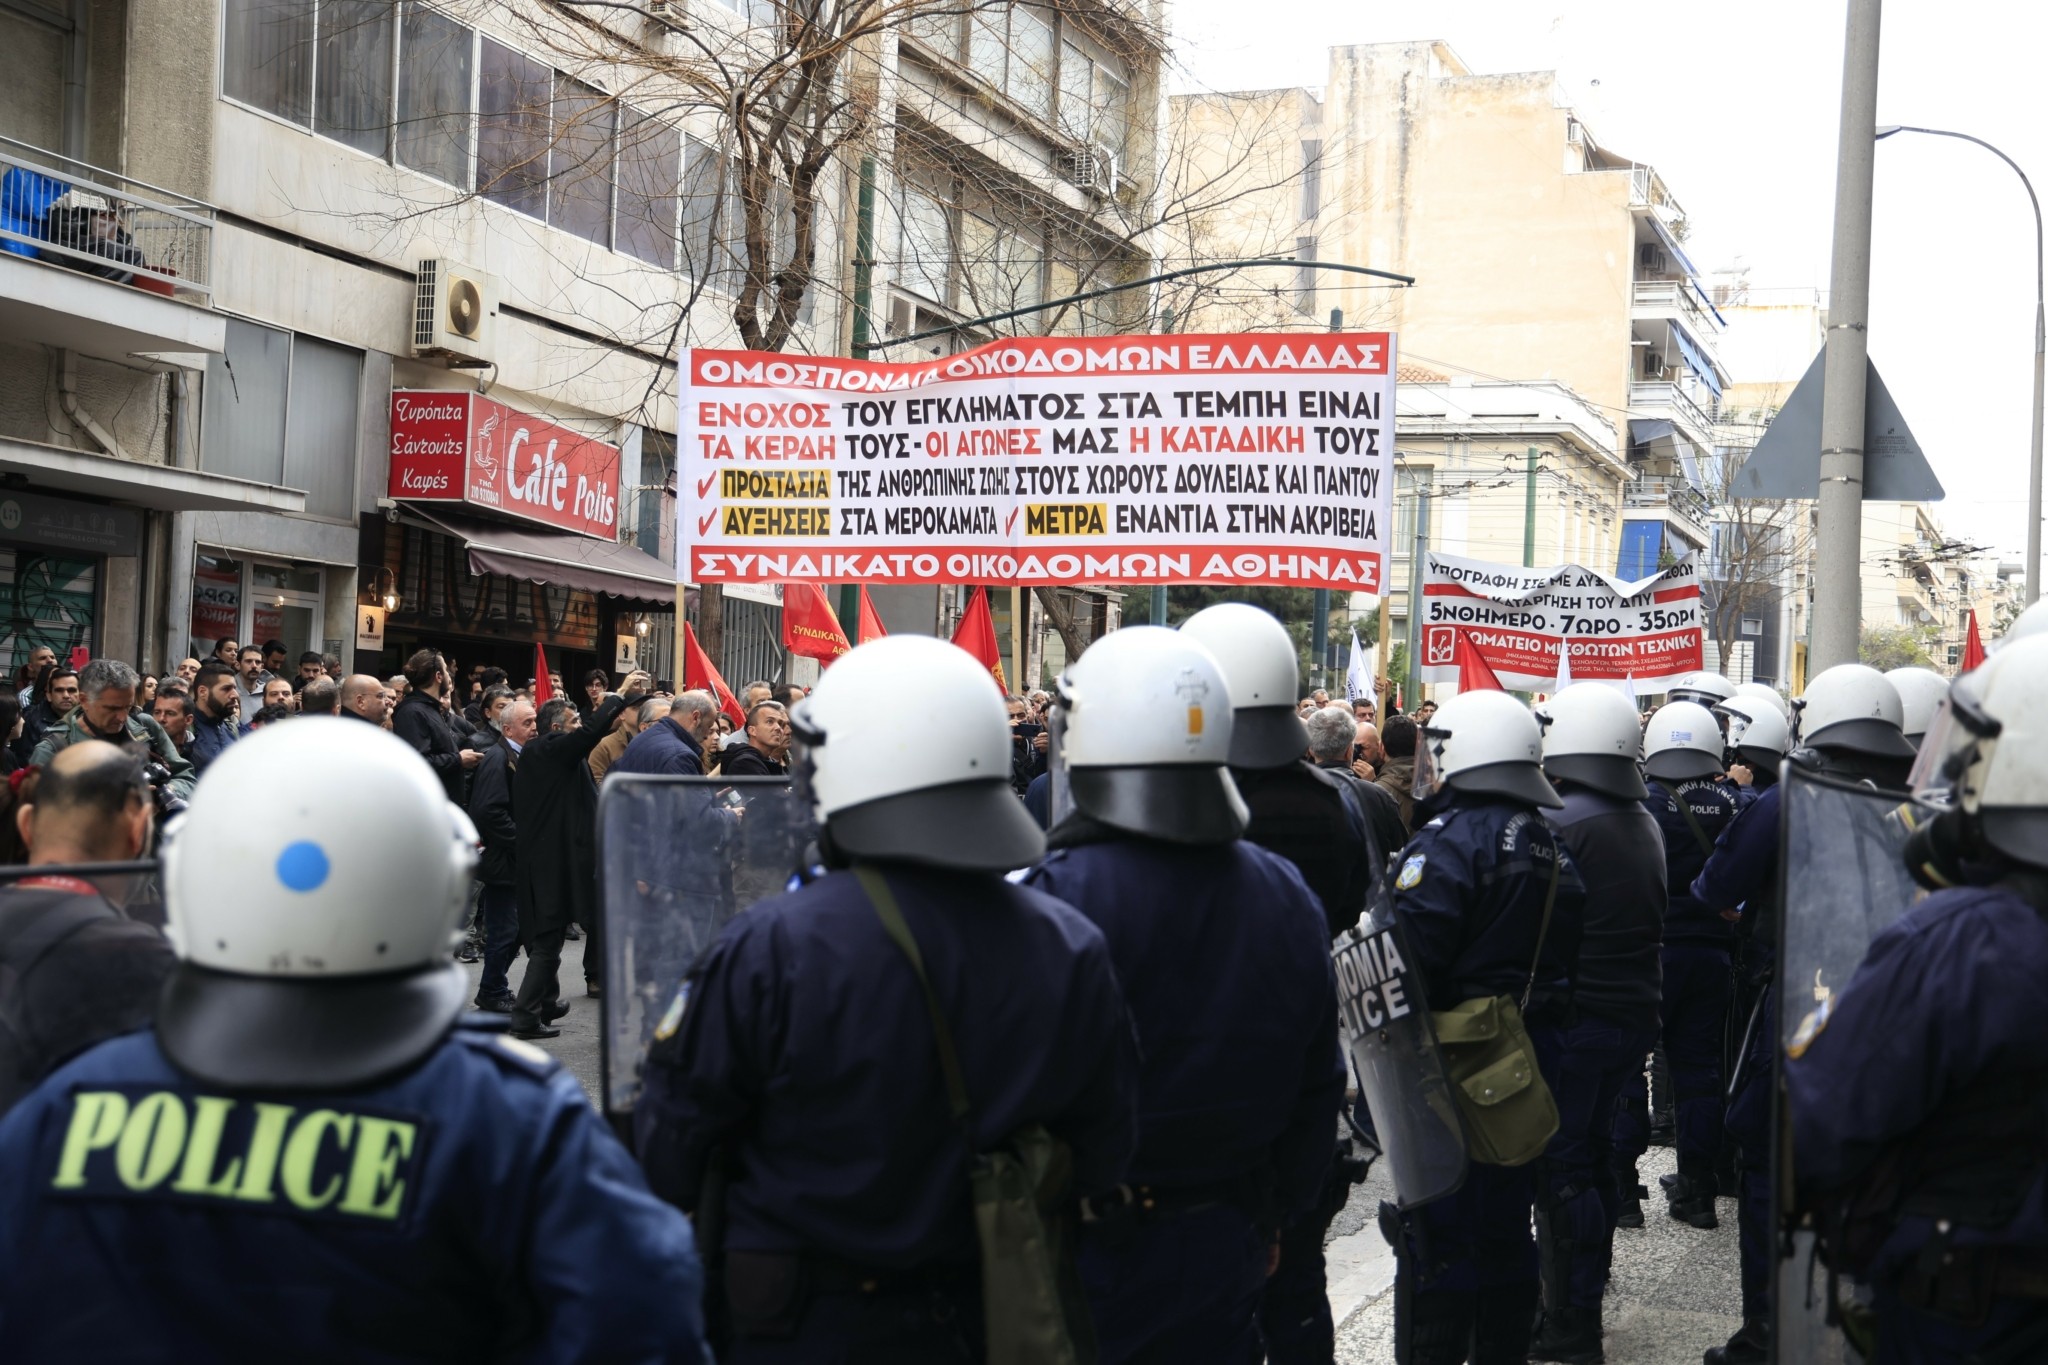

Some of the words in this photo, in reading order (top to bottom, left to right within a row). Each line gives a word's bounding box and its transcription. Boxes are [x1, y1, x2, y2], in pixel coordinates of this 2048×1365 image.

[700, 359, 945, 391] ΟΜΟΣΠΟΝΔΙΑ
[947, 346, 1179, 377] ΟΙΚΟΔΟΜΩΝ
[1189, 344, 1380, 370] ΕΛΛΑΔΑΣ
[396, 398, 462, 424] Τυρόπιτα
[698, 402, 831, 428] ΕΝΟΧΟΣ
[842, 400, 896, 427] ΤΟΥ
[907, 393, 1085, 425] ΕΓΚΛΗΜΑΤΟΣ
[1097, 392, 1162, 419] ΣΤΑ
[1173, 391, 1286, 418] ΤΕΜΠΗ
[1299, 391, 1380, 420] ΕΙΝΑΙ
[698, 434, 734, 459] ΤΑ
[745, 435, 835, 460] ΚΕΡΔΗ
[956, 428, 1041, 456] ΑΓΩΝΕΣ
[1053, 427, 1118, 454] ΜΑΣ
[1130, 426, 1149, 453] Η
[1161, 425, 1304, 453] ΚΑΤΑΔΙΚΗ
[1314, 426, 1379, 456] ΤΟΥΣ
[401, 467, 448, 493] Καφές
[507, 428, 568, 511] Cafe
[573, 473, 615, 526] Polis
[724, 470, 829, 498] ΠΡΟΣΤΑΣΙΑ
[837, 470, 871, 497] ΤΗΣ
[877, 467, 976, 497] ΑΝΘΡΩΠΙΝΗΣ
[980, 466, 1010, 496] ΖΩΗΣ
[1015, 465, 1079, 495] ΣΤΟΥΣ
[1087, 465, 1167, 494] ΧΩΡΟΥΣ
[1174, 464, 1269, 494] ΔΟΥΛΕΙΑΣ
[1276, 465, 1307, 494] ΚΑΙ
[1314, 466, 1379, 499] ΠΑΝΤΟΥ
[724, 508, 830, 535] ΑΥΞΗΣΕΙΣ
[840, 508, 878, 535] ΣΤΑ
[885, 506, 998, 535] ΜΕΡΟΚΑΜΑΤΑ
[1027, 505, 1104, 535] ΜΕΤΡΑ
[1116, 504, 1219, 533] ΕΝΑΝΤΙΑ
[1226, 504, 1286, 533] ΣΤΗΝ
[1290, 505, 1377, 540] ΑΚΡΙΒΕΙΑ
[698, 554, 940, 577] ΣΥΝΔΙΚΑΤΟ
[946, 554, 1190, 578] ΟΙΚΟΔΟΜΩΝ
[1200, 554, 1377, 585] ΑΘΗΝΑΣ
[1430, 562, 1518, 590] ΥΠΟΓΡΑΦΗ
[1549, 574, 1571, 587] ΜΕ
[1586, 596, 1615, 609] ΤΟΥ
[1620, 593, 1652, 608] ΔΠΥ
[1430, 602, 1546, 630] 5ΝΘΗΜΕΡΟ
[1560, 614, 1620, 634] 7ΩΡΟ
[793, 625, 845, 645] ΣΥΝΔΙΚΑΤΟ
[1458, 631, 1540, 652] ΩΜΑΤΕΙΟ
[1689, 805, 1720, 815] POLICE
[1334, 930, 1407, 1003] ΝΟΜΙΑ
[1340, 977, 1411, 1041] LICE
[53, 1091, 416, 1219] POLICE
